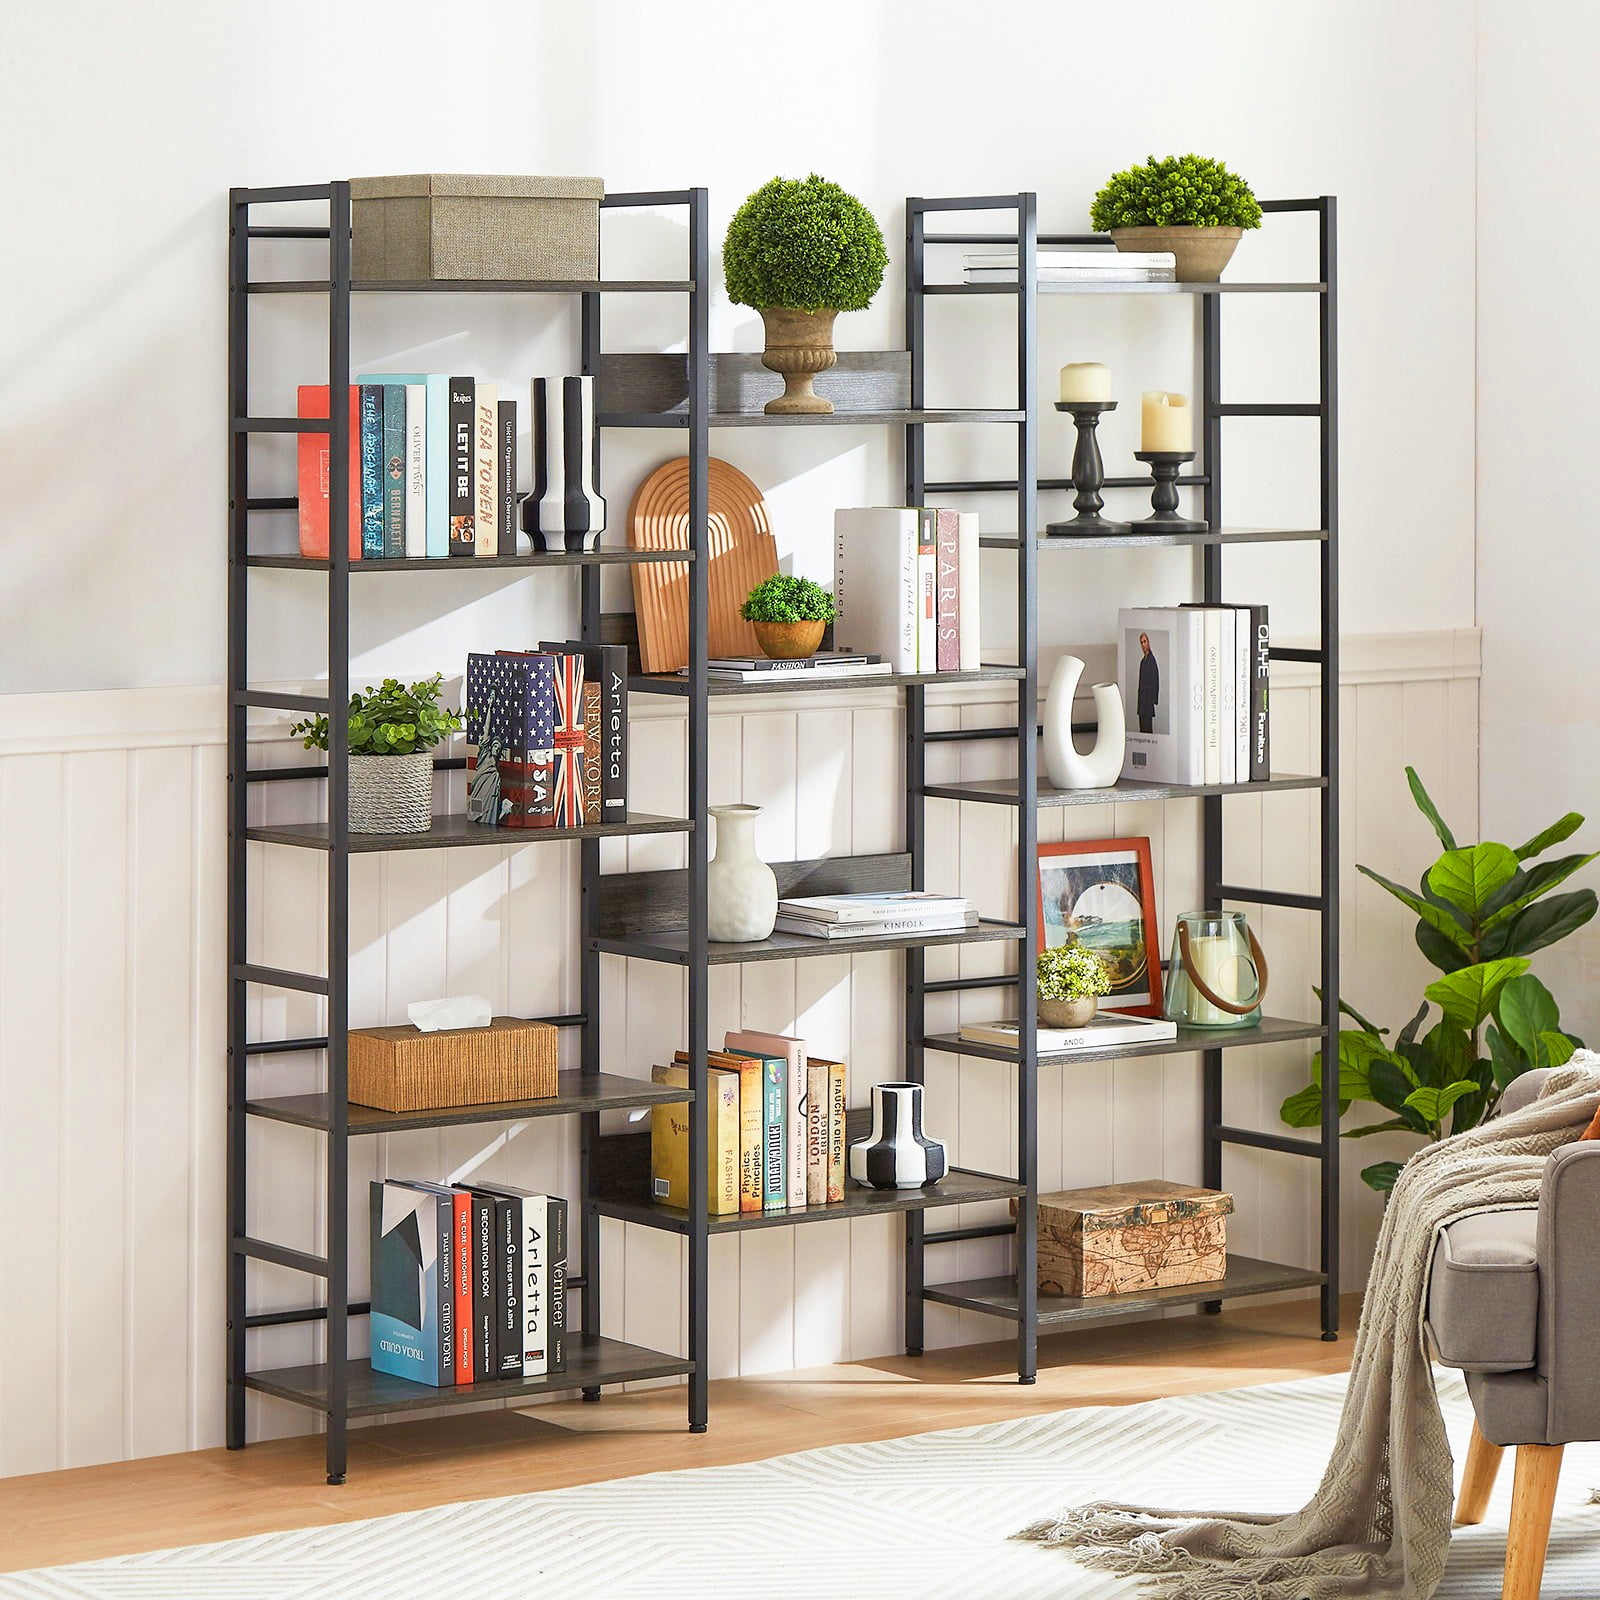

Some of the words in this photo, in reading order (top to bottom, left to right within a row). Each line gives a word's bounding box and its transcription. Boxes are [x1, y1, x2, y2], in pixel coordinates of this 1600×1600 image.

[412, 426, 421, 463] OLIVER
[457, 423, 469, 453] LET
[479, 405, 494, 451] PISA
[412, 465, 422, 497] TWIST
[457, 457, 469, 473] IT
[457, 475, 469, 498] BE
[940, 540, 957, 640] PARIS
[771, 661, 806, 671] FASHION
[587, 695, 601, 743] NEW
[610, 671, 624, 779] Arletta
[1209, 728, 1217, 748] How
[532, 750, 548, 803] USA
[587, 755, 601, 814] YORK
[884, 919, 925, 930] KINFOLK
[1064, 1037, 1084, 1046] ANDO
[810, 1104, 820, 1166] LONDON
[820, 1113, 828, 1155] BRIDGE
[724, 1149, 734, 1202] FASHION
[741, 1150, 752, 1194] Physics
[751, 1144, 762, 1198] Principles
[767, 1124, 782, 1193] EDUCATION
[481, 1208, 490, 1271] DECORATION
[481, 1271, 489, 1298] BOOK
[526, 1226, 543, 1335] Arletta
[552, 1258, 569, 1328] Vermeer
[443, 1302, 451, 1333] GUILD
[380, 1339, 401, 1355] GUILD
[401, 1345, 425, 1361] TRICIA
[443, 1334, 452, 1369] TRICIA
